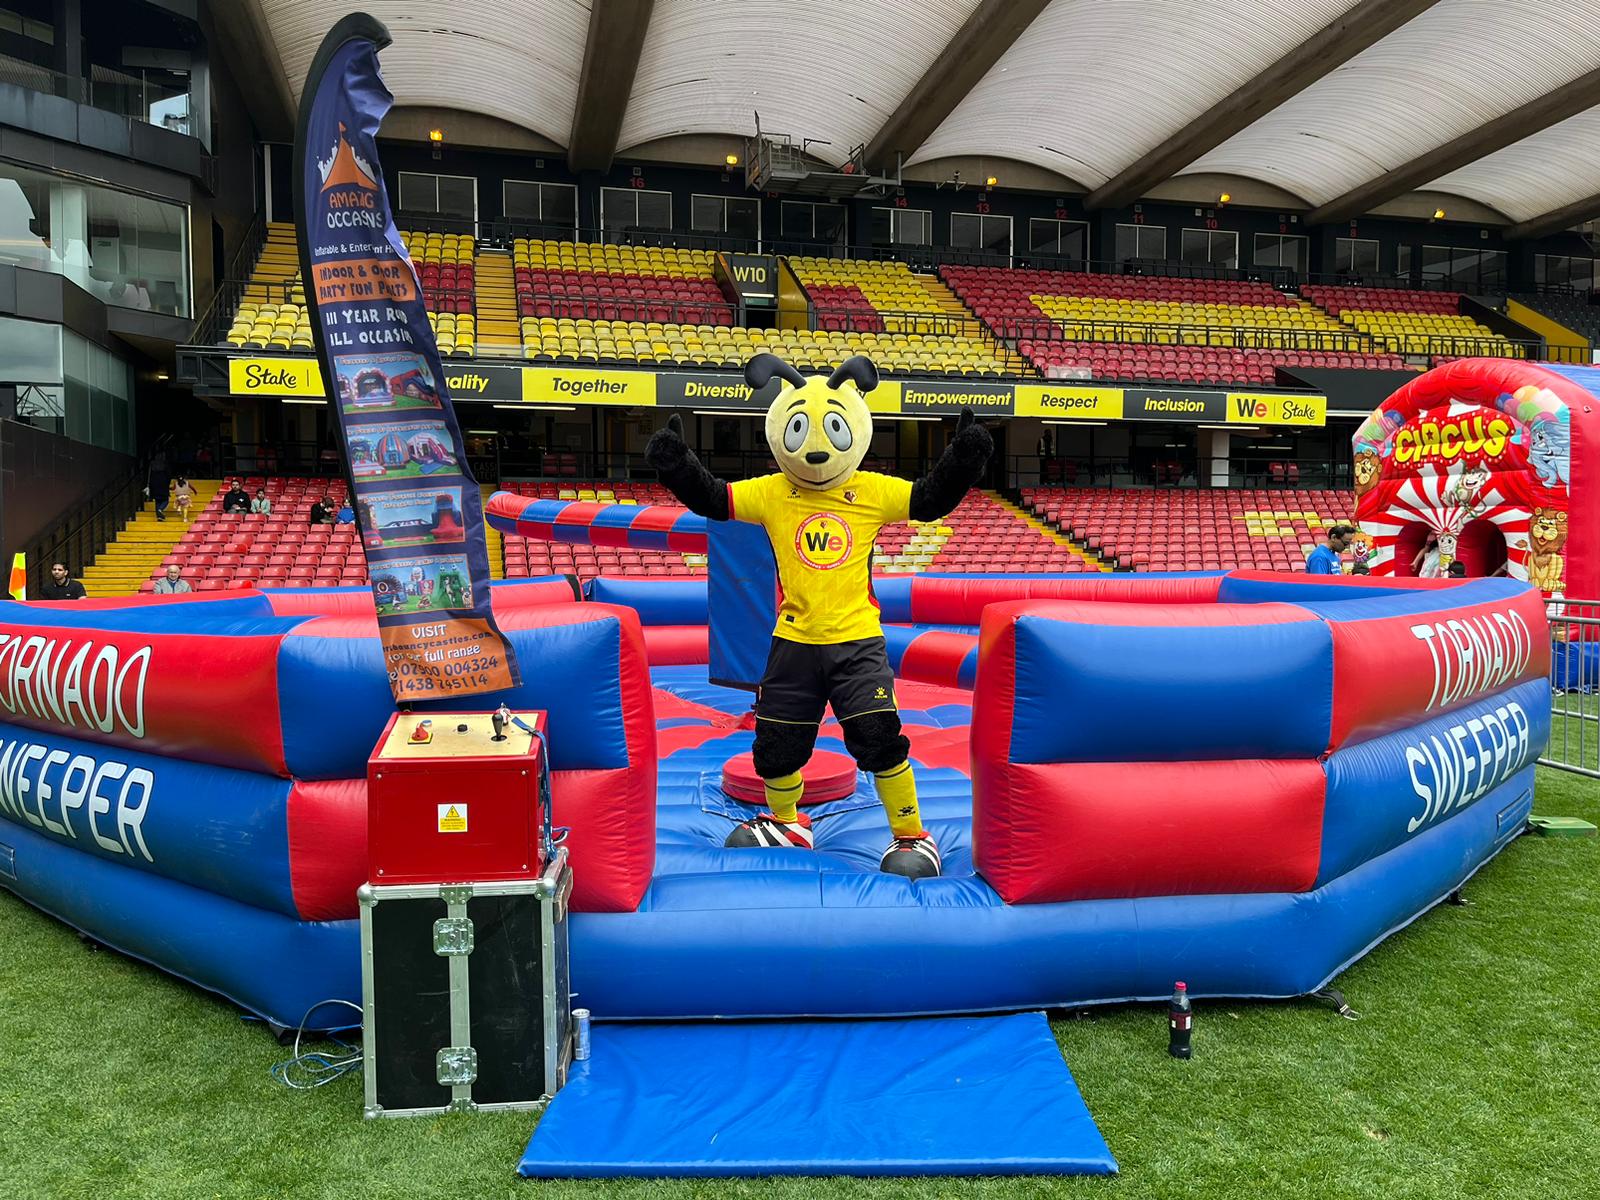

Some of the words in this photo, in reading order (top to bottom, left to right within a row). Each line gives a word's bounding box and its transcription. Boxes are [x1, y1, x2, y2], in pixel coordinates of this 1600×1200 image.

[630, 177, 645, 188] 16
[976, 203, 990, 213] 13
[1055, 209, 1067, 219] 12
[1205, 219, 1218, 229] 10
[358, 264, 367, 278] &
[733, 266, 766, 283] W10
[342, 308, 380, 324] YEAR
[245, 364, 297, 389] Stake
[552, 377, 628, 396] Together
[684, 382, 753, 401] Diversity
[904, 390, 1012, 407] Empowerment
[1040, 394, 1098, 410] Respect
[1144, 398, 1205, 412] Inclusion
[1237, 399, 1268, 417] We
[1282, 401, 1316, 421] Stake
[1395, 416, 1510, 463] CIRCUS
[805, 532, 843, 552] We
[411, 624, 447, 639] VISIT
[424, 650, 444, 663] full
[448, 645, 481, 659] range
[1410, 609, 1531, 713] TORNADO
[444, 656, 498, 676] 004324
[1405, 702, 1529, 833] SWEEPER
